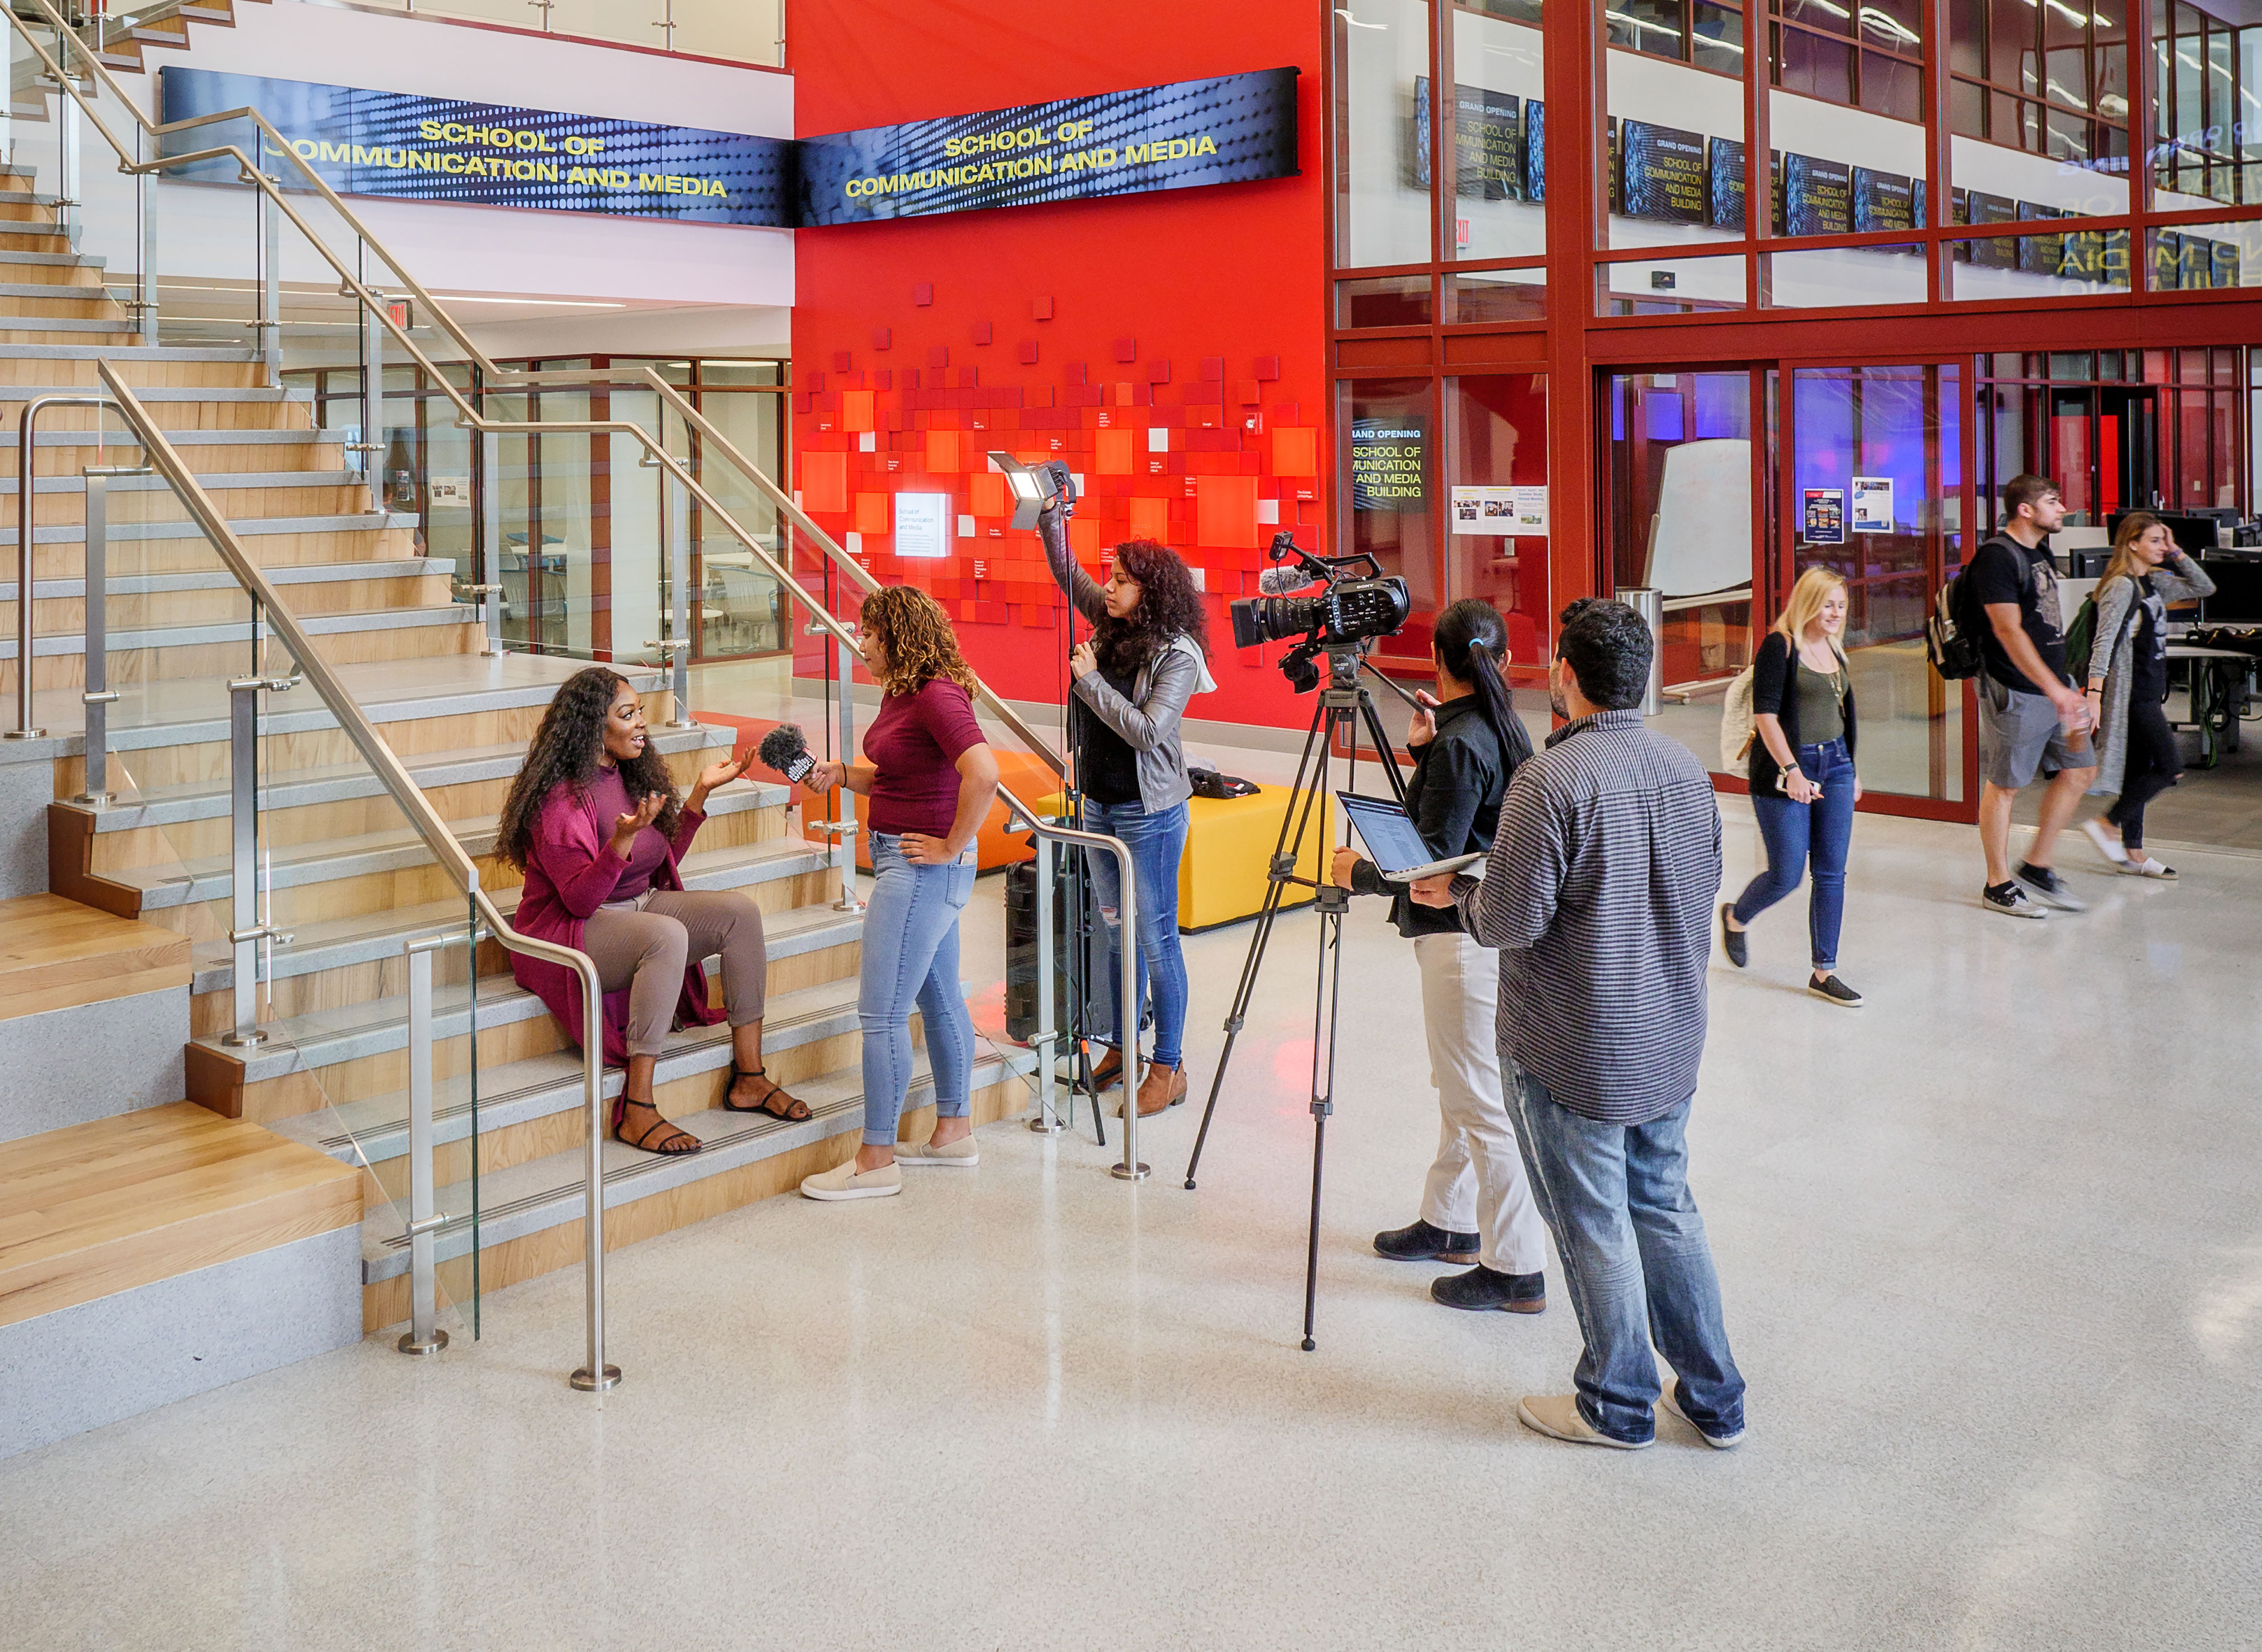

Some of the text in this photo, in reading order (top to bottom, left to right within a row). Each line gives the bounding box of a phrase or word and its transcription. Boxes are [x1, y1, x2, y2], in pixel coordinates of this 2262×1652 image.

[1459, 101, 1516, 118] GRAND OPENING
[420, 120, 604, 156] SCHOOL OF
[946, 120, 1093, 157] SCHOOL OF
[1468, 121, 1516, 140] SCHOOL OF
[1455, 134, 1516, 153] MMUNICATION
[1657, 139, 1702, 154] GRAND OPENING
[846, 136, 1217, 197] COMMUNICATION AND MEDIA
[1469, 151, 1516, 168] AND MEDIA
[1663, 157, 1701, 172] SCHOOL OF
[567, 166, 629, 188] AND
[639, 173, 727, 198] MEDIA
[1477, 167, 1516, 183] BUILDING
[1644, 166, 1702, 185] COMMUNICATION
[1665, 183, 1702, 198] AND MEDIA
[1817, 185, 1847, 198] SCHOOL OF
[1671, 197, 1701, 210] BUILDING
[1457, 219, 1469, 243] XIT
[390, 304, 404, 327] EXIT
[1353, 447, 1421, 457] SCHOOL OF
[1356, 474, 1421, 484] AND MEDIA
[1367, 486, 1421, 497] BUILDING
[792, 761, 813, 782] wmsc
